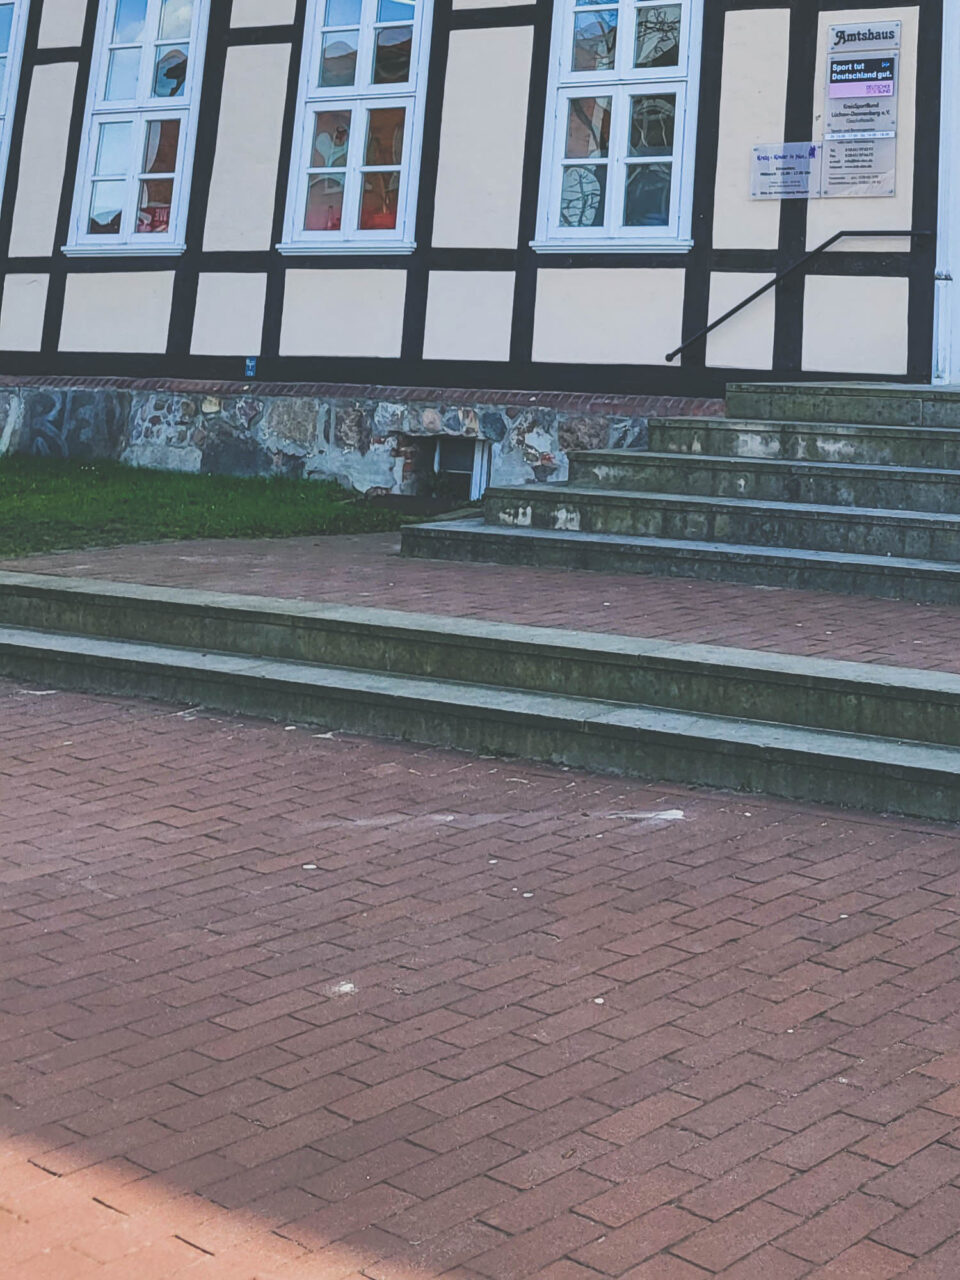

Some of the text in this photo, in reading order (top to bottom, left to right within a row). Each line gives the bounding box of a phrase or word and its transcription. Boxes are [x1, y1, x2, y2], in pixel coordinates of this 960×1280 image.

[834, 28, 895, 46] Amtshaus
[832, 62, 865, 72] Sport tut
[832, 71, 892, 80] Deutschland gut.
